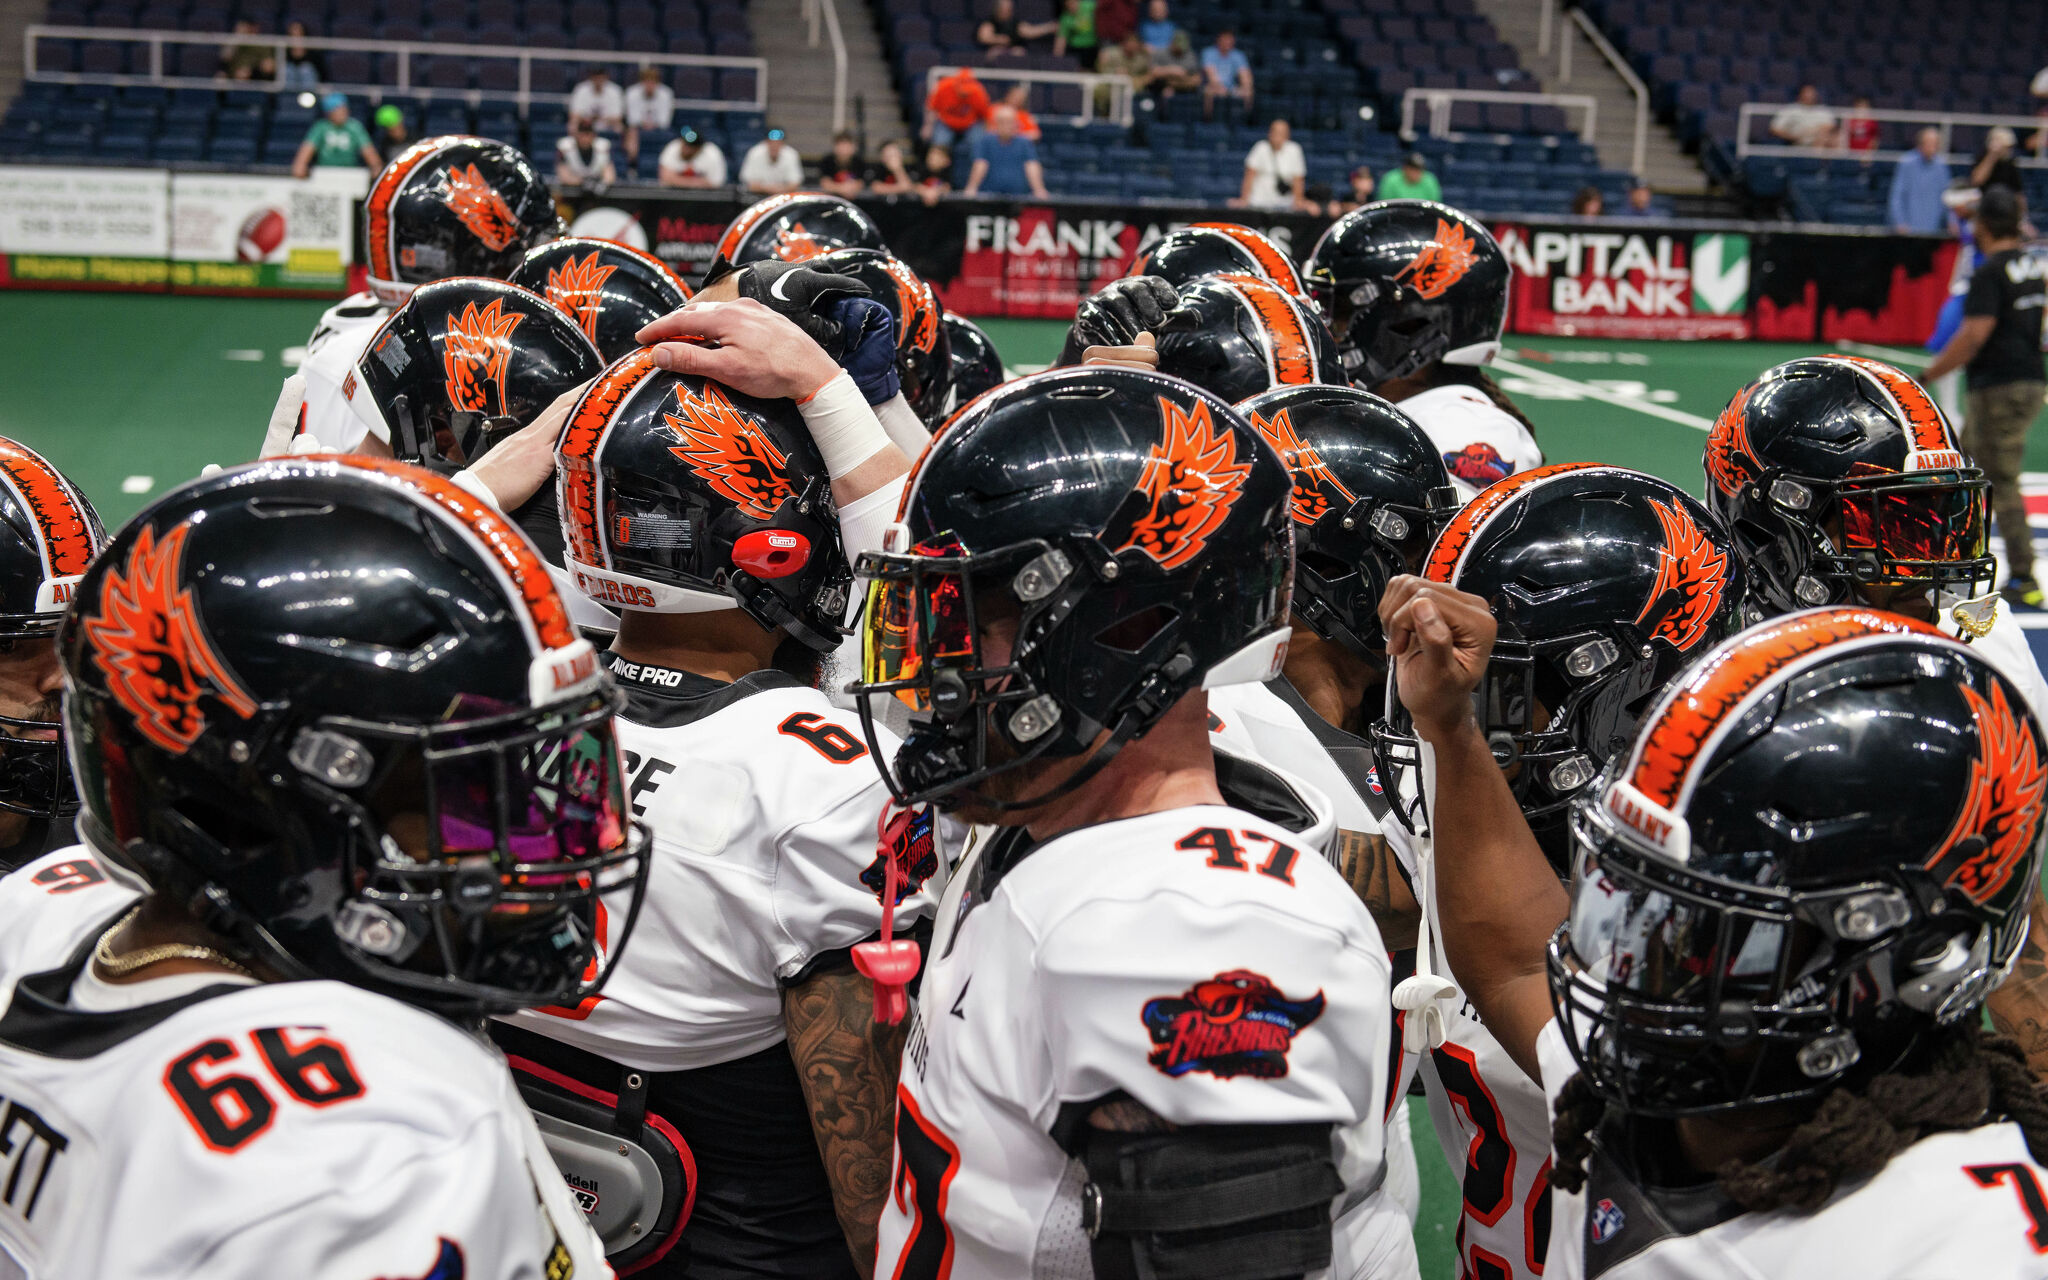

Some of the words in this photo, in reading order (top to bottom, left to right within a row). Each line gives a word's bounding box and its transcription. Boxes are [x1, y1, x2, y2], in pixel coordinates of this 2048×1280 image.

[966, 216, 1125, 258] FRANK
[1500, 229, 1690, 279] APITAL
[1553, 277, 1688, 316] BANK
[620, 516, 630, 543] 6
[638, 512, 668, 520] WARNING
[608, 656, 640, 680] NIKE
[639, 666, 683, 687] PRO
[777, 711, 869, 764] 6
[1610, 788, 1673, 847] ALBANY
[1174, 826, 1300, 888] 47
[162, 1026, 367, 1154] 66
